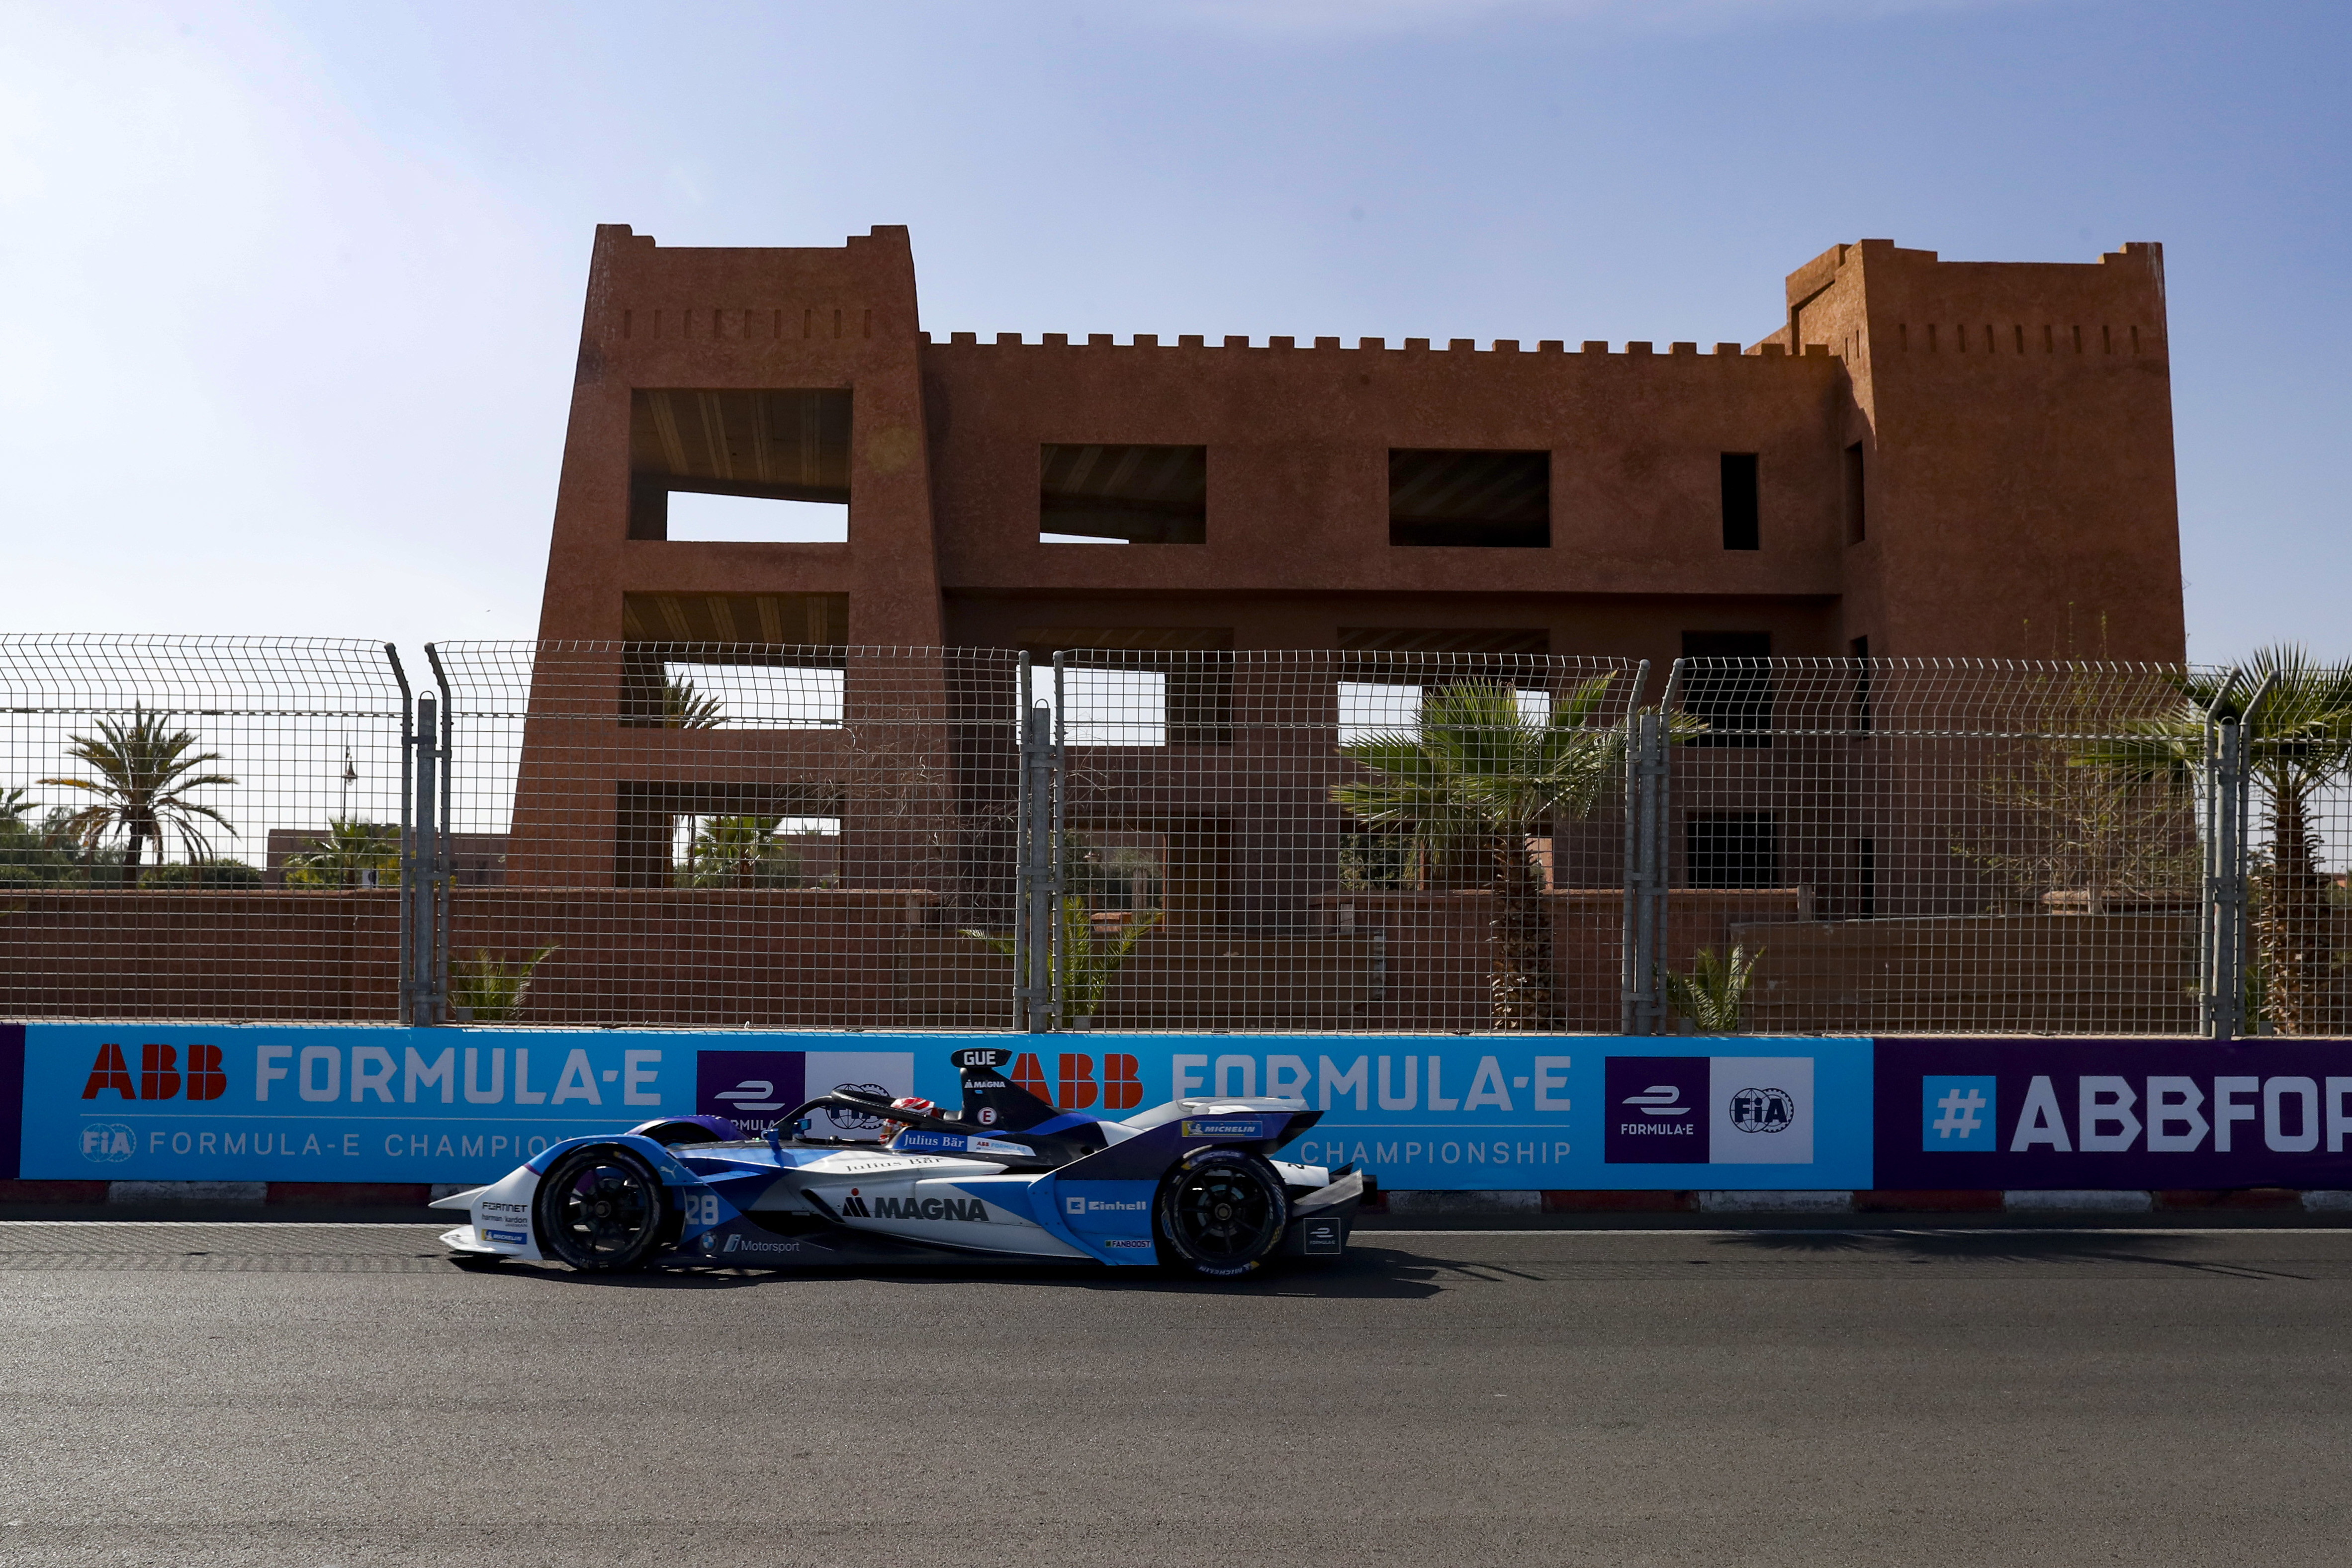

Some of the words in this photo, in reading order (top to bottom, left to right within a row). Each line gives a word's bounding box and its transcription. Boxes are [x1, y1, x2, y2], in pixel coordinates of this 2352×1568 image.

[964, 1051, 996, 1065] GUE
[81, 1044, 227, 1100] ABB
[256, 1045, 662, 1106] FORMULA-E
[1009, 1053, 1144, 1110] ABB
[1172, 1054, 1571, 1112] FORMULA-E
[983, 1110, 992, 1123] E
[1621, 1124, 1694, 1135] FORMULA-E
[150, 1132, 360, 1156] FORMULA-E
[385, 1133, 573, 1158] CHAMPIO
[904, 1134, 938, 1146] Julius
[942, 1136, 965, 1147] Bär
[1300, 1140, 1571, 1164] CHAMPIONSHIP
[846, 1160, 902, 1172] Julius
[908, 1156, 944, 1165] Bär
[687, 1195, 719, 1225] 28
[875, 1197, 990, 1221] MAGNA
[1088, 1201, 1147, 1211] Einhell
[741, 1240, 800, 1253] Motorsport
